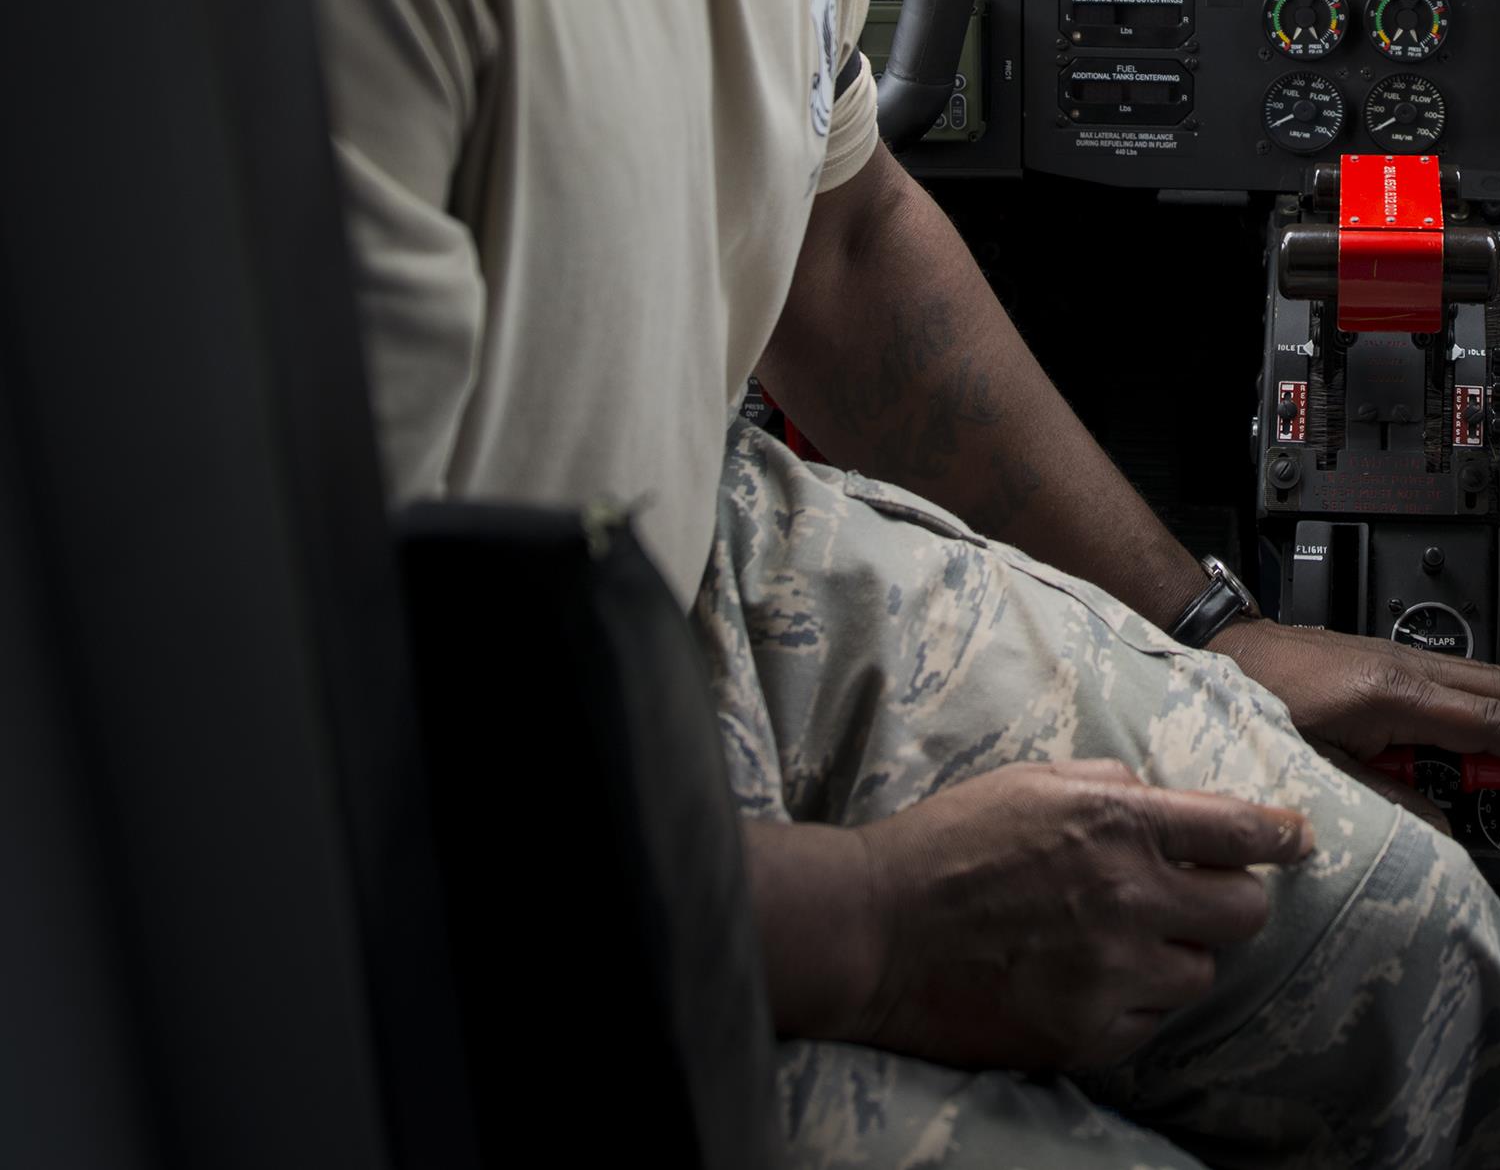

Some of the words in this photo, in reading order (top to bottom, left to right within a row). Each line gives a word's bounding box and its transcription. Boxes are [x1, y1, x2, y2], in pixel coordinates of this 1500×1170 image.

[1120, 27, 1133, 35] Lbs
[1116, 64, 1138, 73] FUEL
[1071, 72, 1111, 80] ADDITIONAL
[1112, 72, 1134, 81] TANKS
[1135, 73, 1181, 82] CENTERWING
[1282, 88, 1300, 98] FUEL
[1309, 92, 1331, 102] FLOW
[1383, 91, 1401, 100] FUEL
[1410, 94, 1432, 104] FLOW
[1080, 131, 1094, 139] MAX
[1094, 132, 1121, 140] LATERAL
[1122, 132, 1138, 140] FUEL
[1075, 139, 1100, 147] DURING
[1277, 343, 1296, 352] IDLE
[1467, 348, 1487, 357] IDLE
[1298, 384, 1306, 440] REVERSE
[1295, 544, 1328, 555] FLIGHT
[1428, 636, 1456, 647] FLAPS
